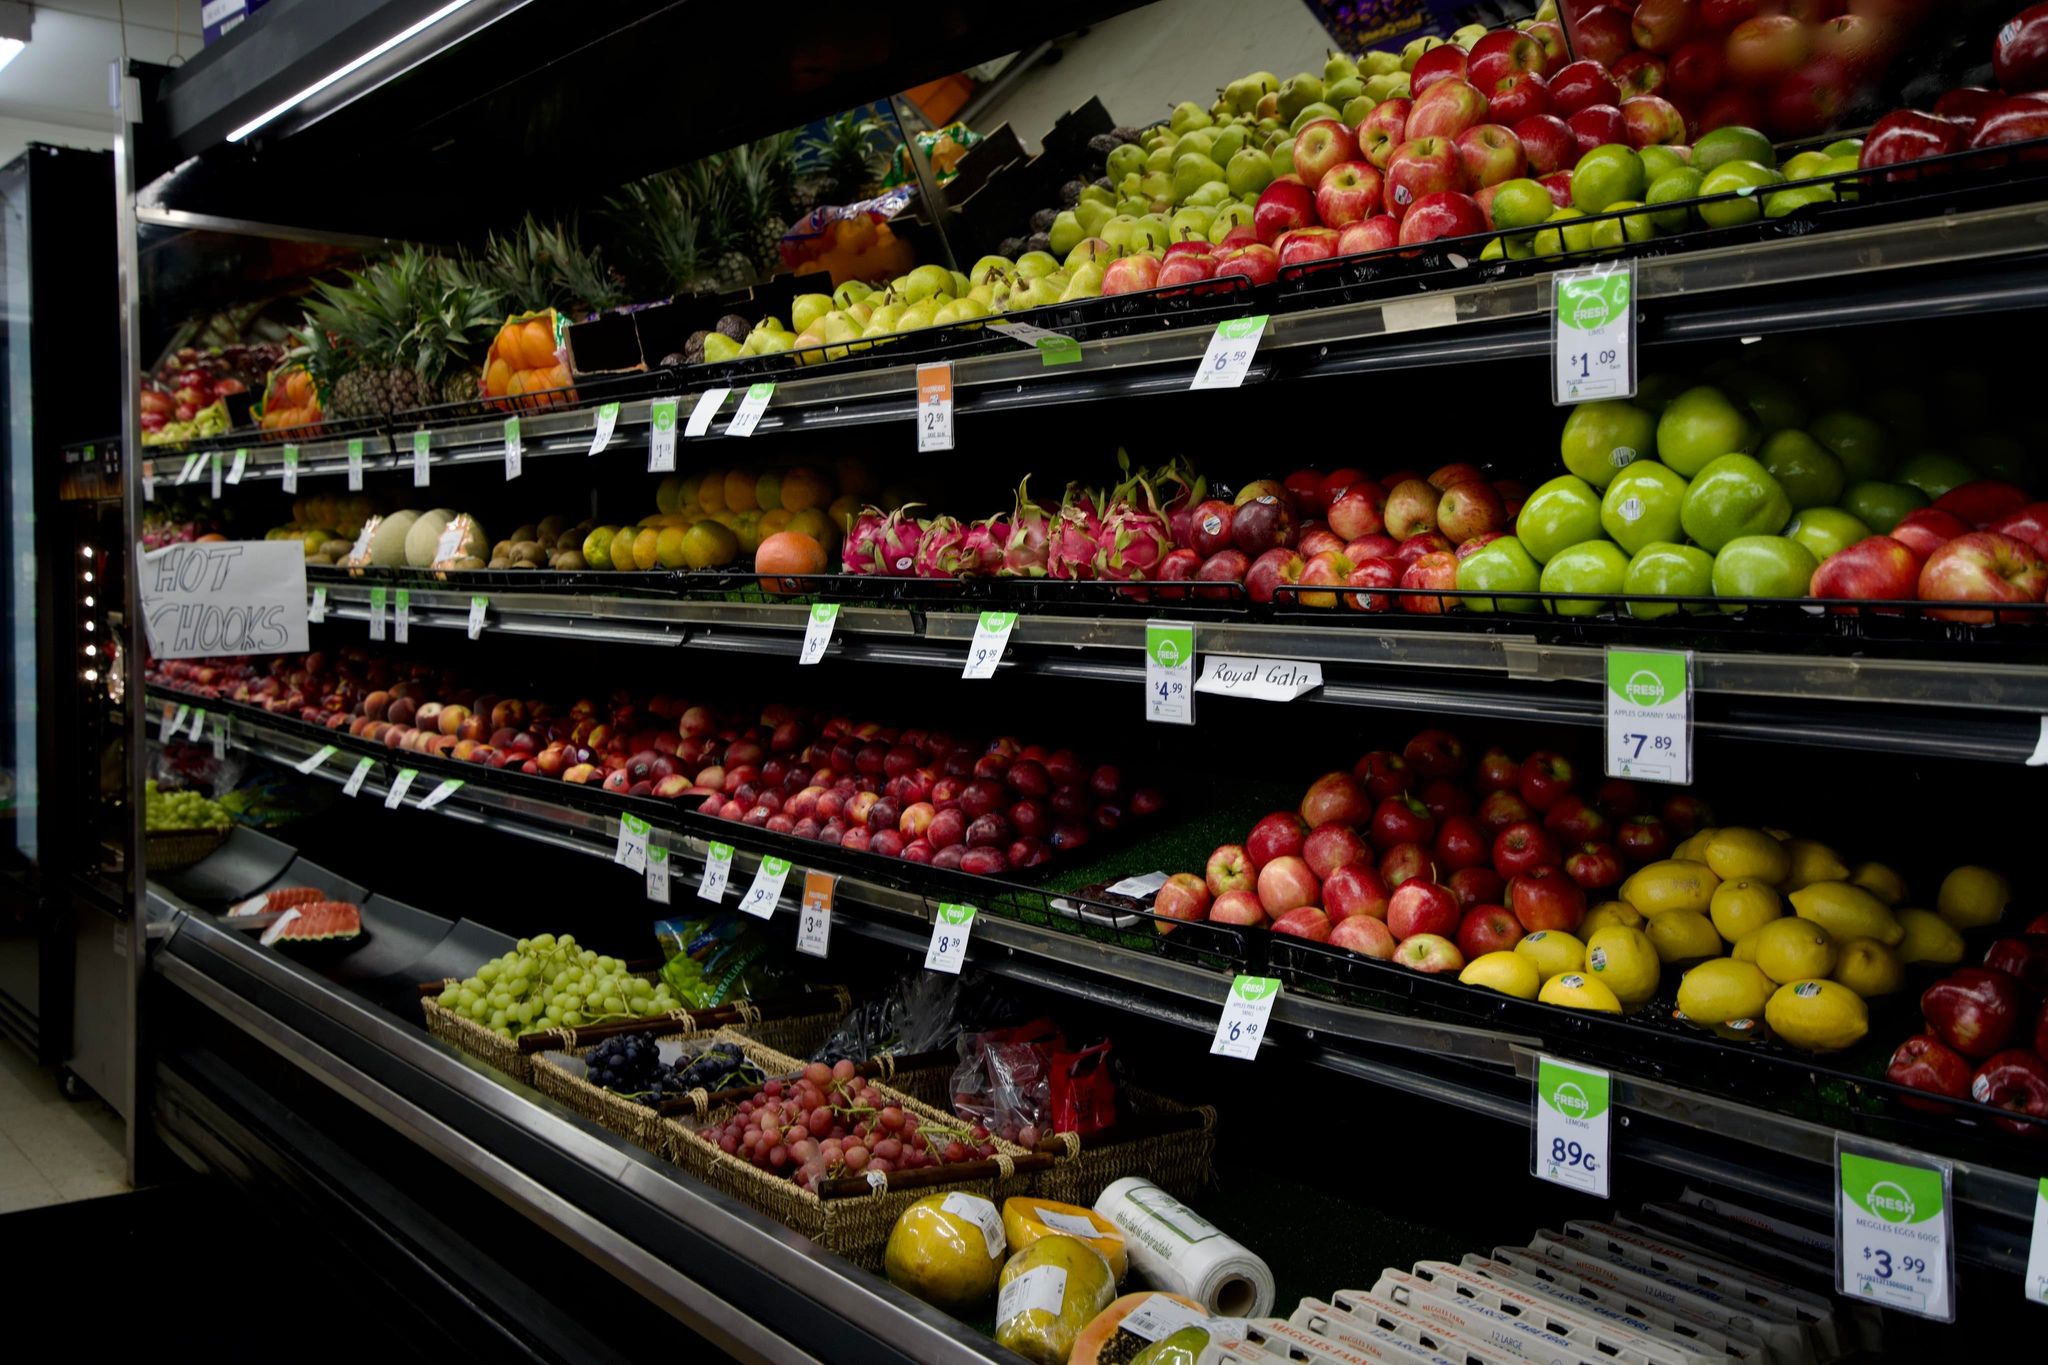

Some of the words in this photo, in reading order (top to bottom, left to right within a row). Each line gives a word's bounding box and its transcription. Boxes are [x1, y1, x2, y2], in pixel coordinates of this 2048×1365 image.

[1574, 306, 1609, 320] FRESH
[1213, 351, 1247, 370] $6.59
[1571, 350, 1616, 377] $1.09
[154, 545, 244, 593] HOT
[150, 602, 288, 652] CHOOKS
[1157, 651, 1179, 660] FRESH
[1212, 662, 1259, 688] Royal
[1265, 664, 1309, 687] Gala
[1155, 681, 1183, 701] $4.99
[1626, 683, 1665, 697] FRESH
[1614, 708, 1636, 718] APPLES
[1637, 710, 1665, 719] GRANNY
[1666, 712, 1687, 720] SMITH
[1623, 733, 1673, 760] $7.89
[938, 936, 960, 953] $8.39
[1242, 983, 1263, 993] FRESH
[1228, 1021, 1258, 1041] $6.49
[1553, 1092, 1589, 1111] FRESH
[1565, 1117, 1590, 1130] LEMONS
[1866, 1193, 1916, 1215] FRESH
[1856, 1217, 1893, 1233] MEGGLES
[1894, 1226, 1916, 1239] EGGS
[1917, 1232, 1940, 1245] 600G
[1863, 1245, 1926, 1279] $3.99
[1440, 1264, 1498, 1292] MEGGLES
[1498, 1287, 1537, 1306] FARM
[1269, 1321, 1333, 1352] MEGGLES
[1491, 1329, 1503, 1343] 12
[1502, 1334, 1523, 1351] LARGE
